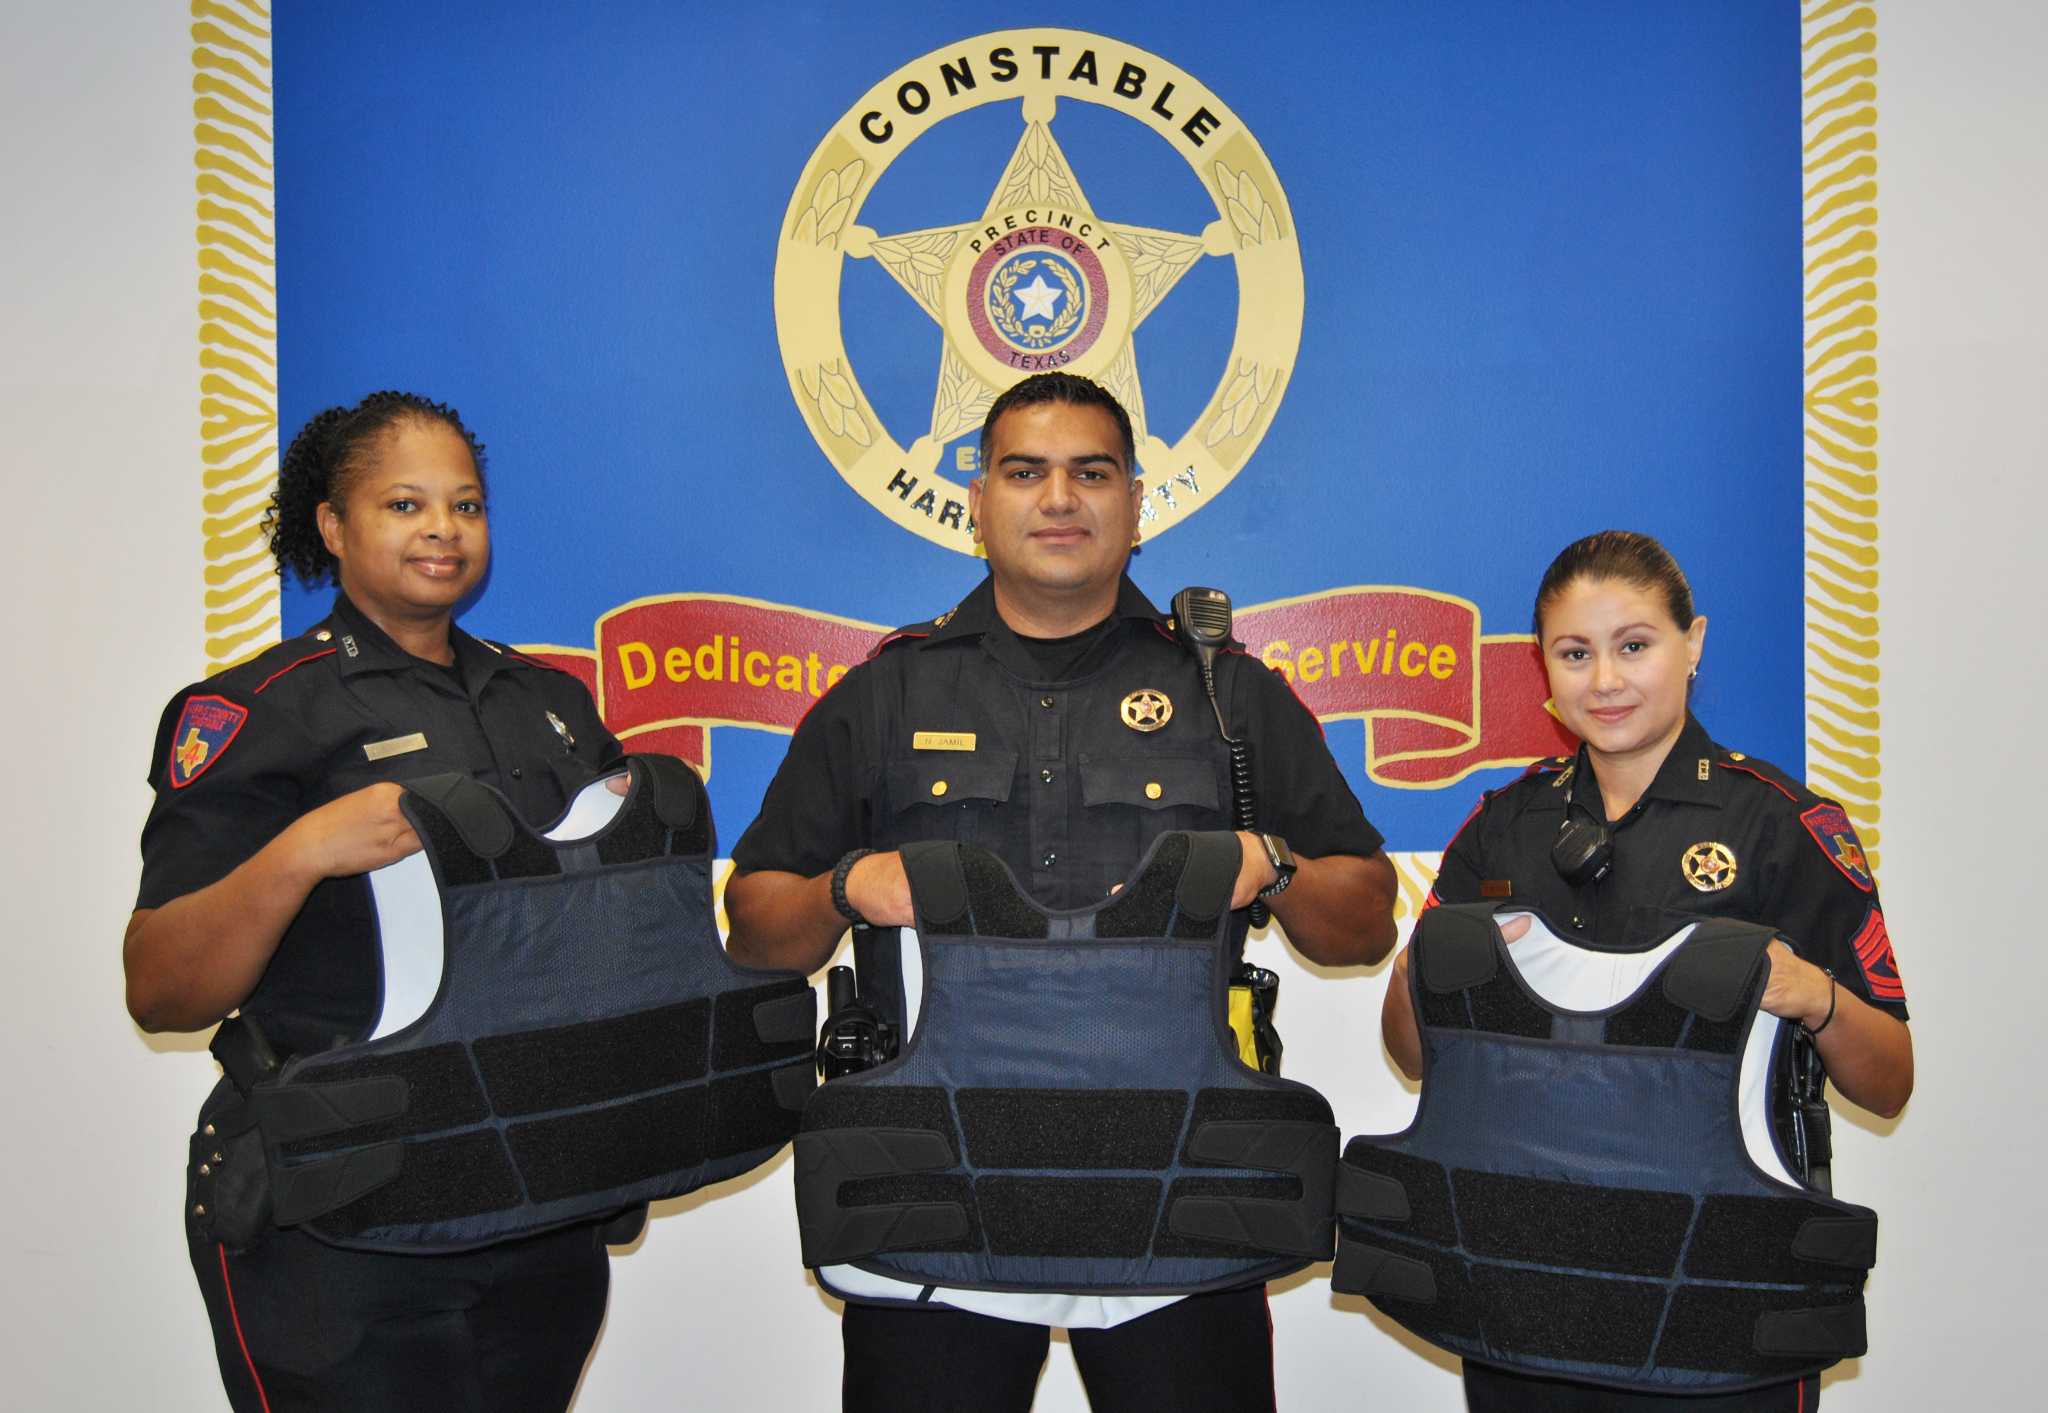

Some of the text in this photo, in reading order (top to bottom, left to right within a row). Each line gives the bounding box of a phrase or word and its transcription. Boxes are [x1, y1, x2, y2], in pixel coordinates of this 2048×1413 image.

[859, 46, 1221, 147] CONSTABLE
[970, 210, 1110, 253] PRECINCT
[993, 230, 1086, 256] STATE OF
[1010, 350, 1071, 369] TEXAS
[1262, 628, 1457, 685] Service
